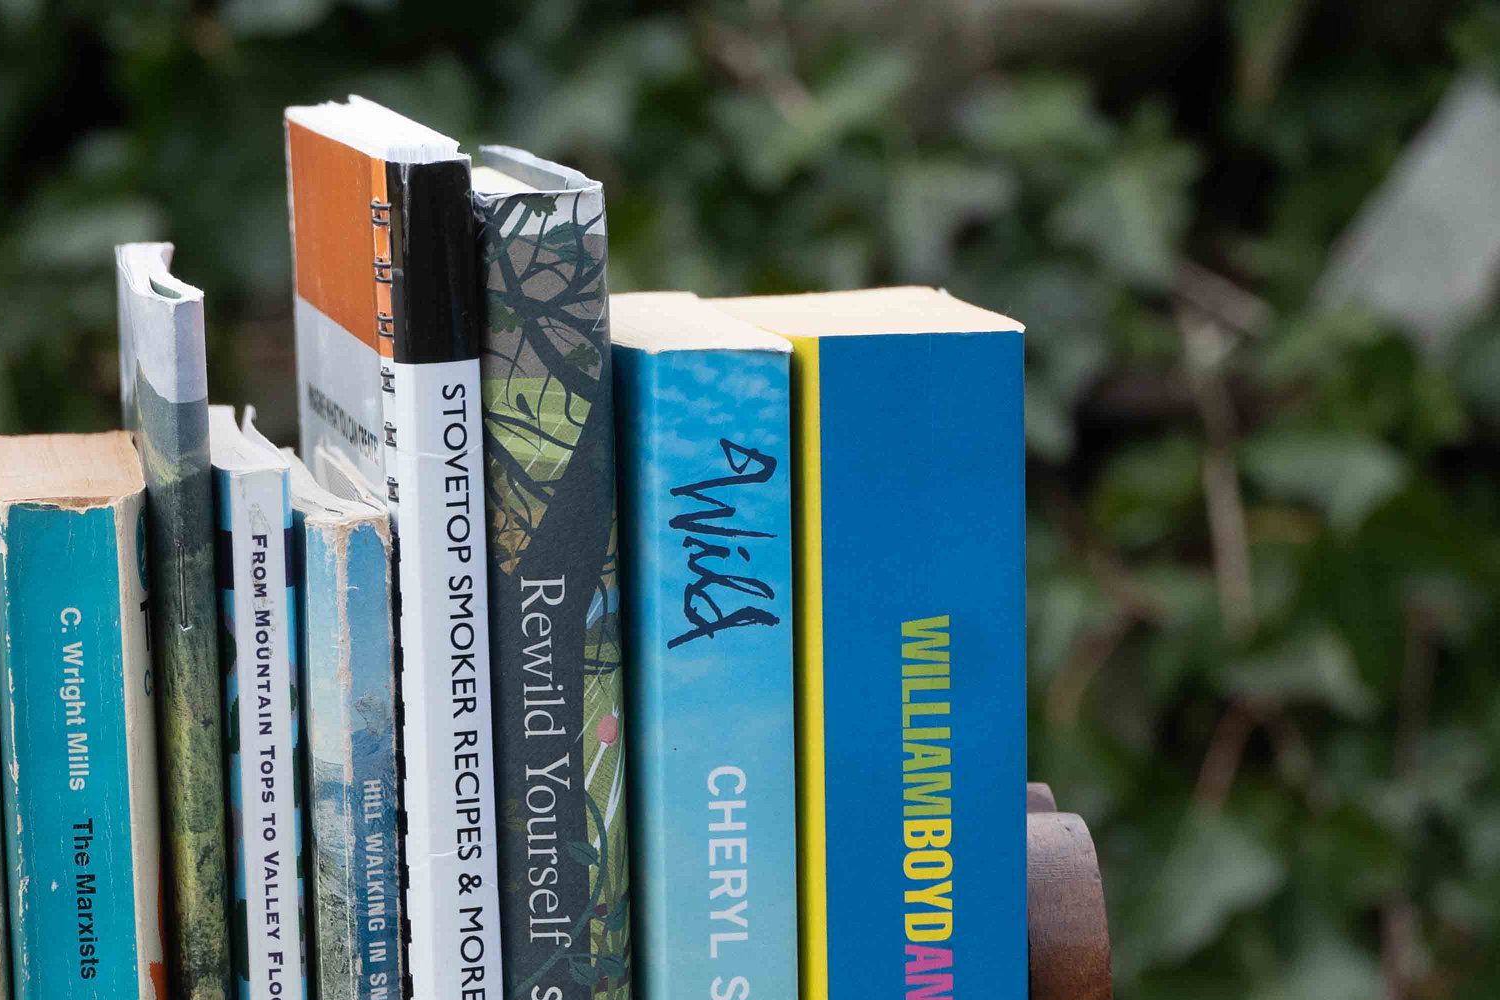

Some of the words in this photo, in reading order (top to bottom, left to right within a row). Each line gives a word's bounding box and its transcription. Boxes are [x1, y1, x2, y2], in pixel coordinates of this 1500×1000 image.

[441, 383, 473, 563] STOVETOP
[251, 533, 268, 598] FROM
[60, 606, 83, 634] C.
[447, 575, 477, 719] SMOKER
[519, 574, 566, 740] Rewild
[59, 641, 86, 726] Wright
[255, 610, 273, 735] MOUNTAIN
[67, 731, 90, 792] Mills
[259, 745, 276, 804] TOPS
[363, 779, 380, 822] HILL
[453, 730, 483, 862] RECIPES
[71, 818, 93, 866] The
[261, 813, 277, 842] TO
[525, 752, 572, 948] Yourself
[706, 765, 749, 959] CHERYL
[263, 850, 281, 941] VALLEY
[364, 832, 385, 932] WALKING
[457, 872, 483, 896] &
[74, 873, 97, 980] Marxists
[368, 940, 386, 962] IN
